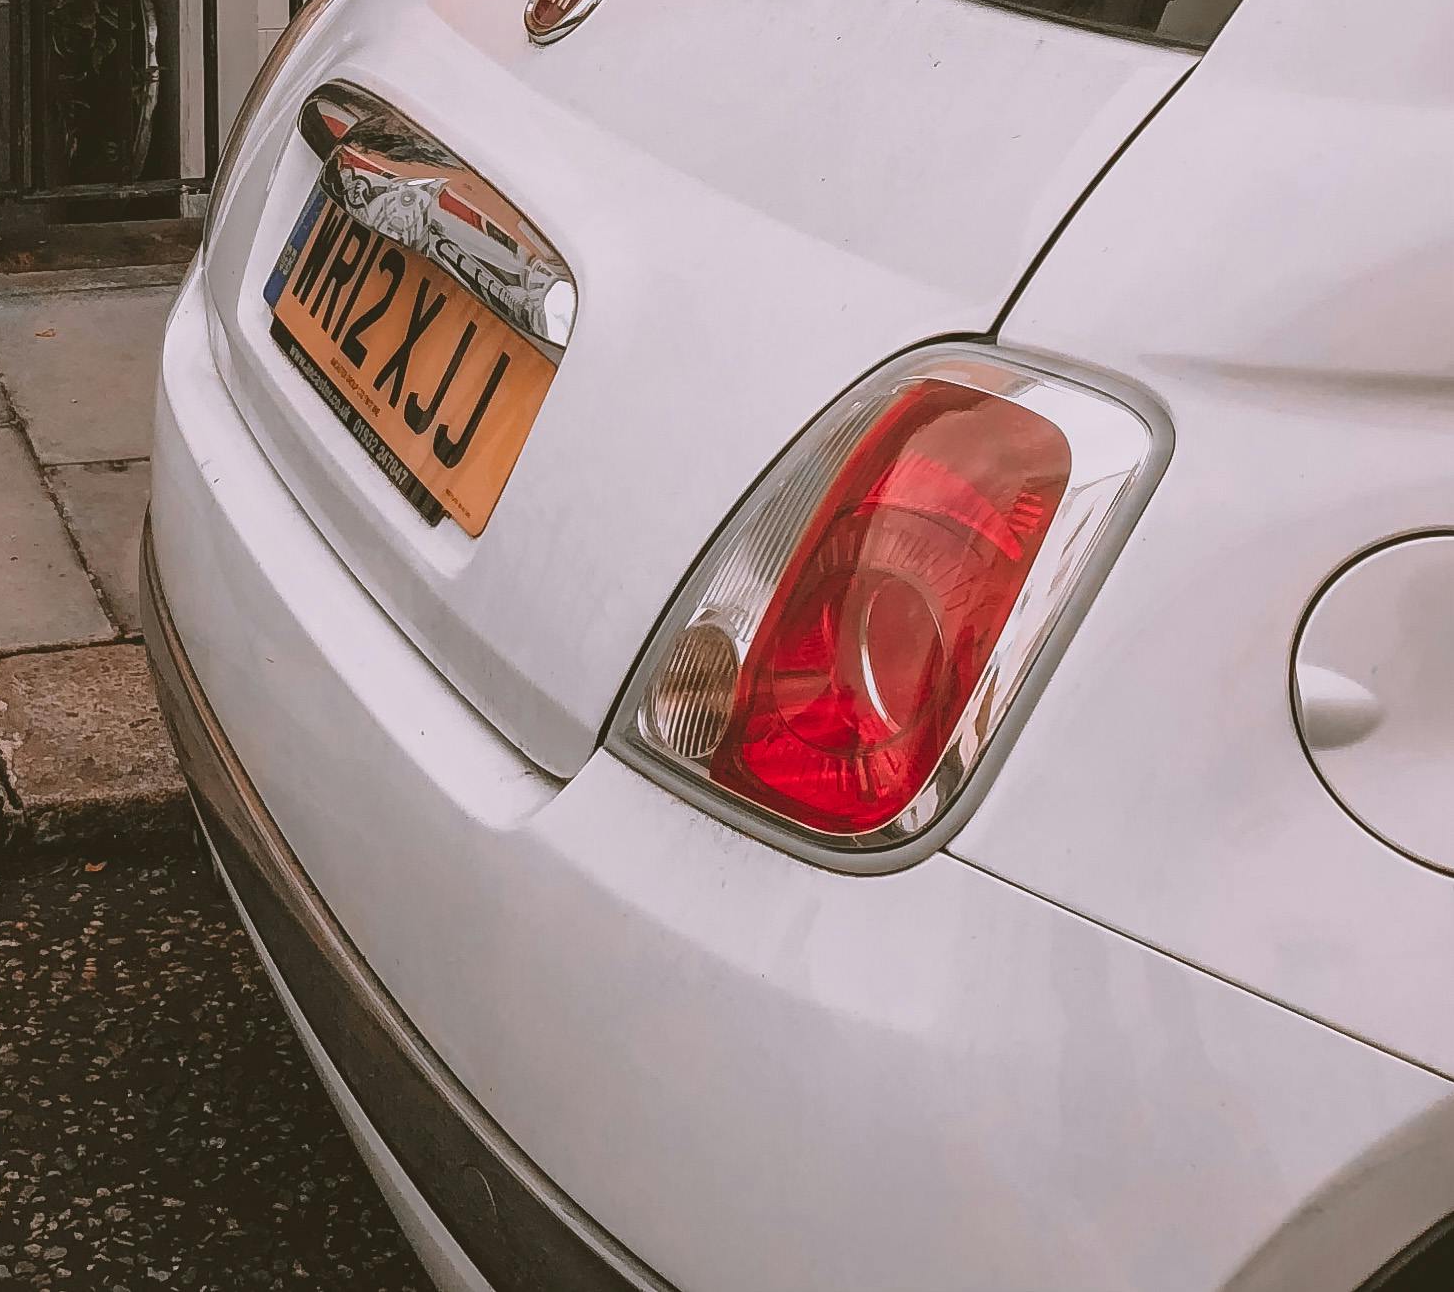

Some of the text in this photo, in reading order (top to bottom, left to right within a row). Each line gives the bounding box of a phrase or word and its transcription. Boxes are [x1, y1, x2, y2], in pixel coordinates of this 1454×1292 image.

[292, 201, 510, 469] WR12 XJJ
[353, 418, 379, 453] 01932
